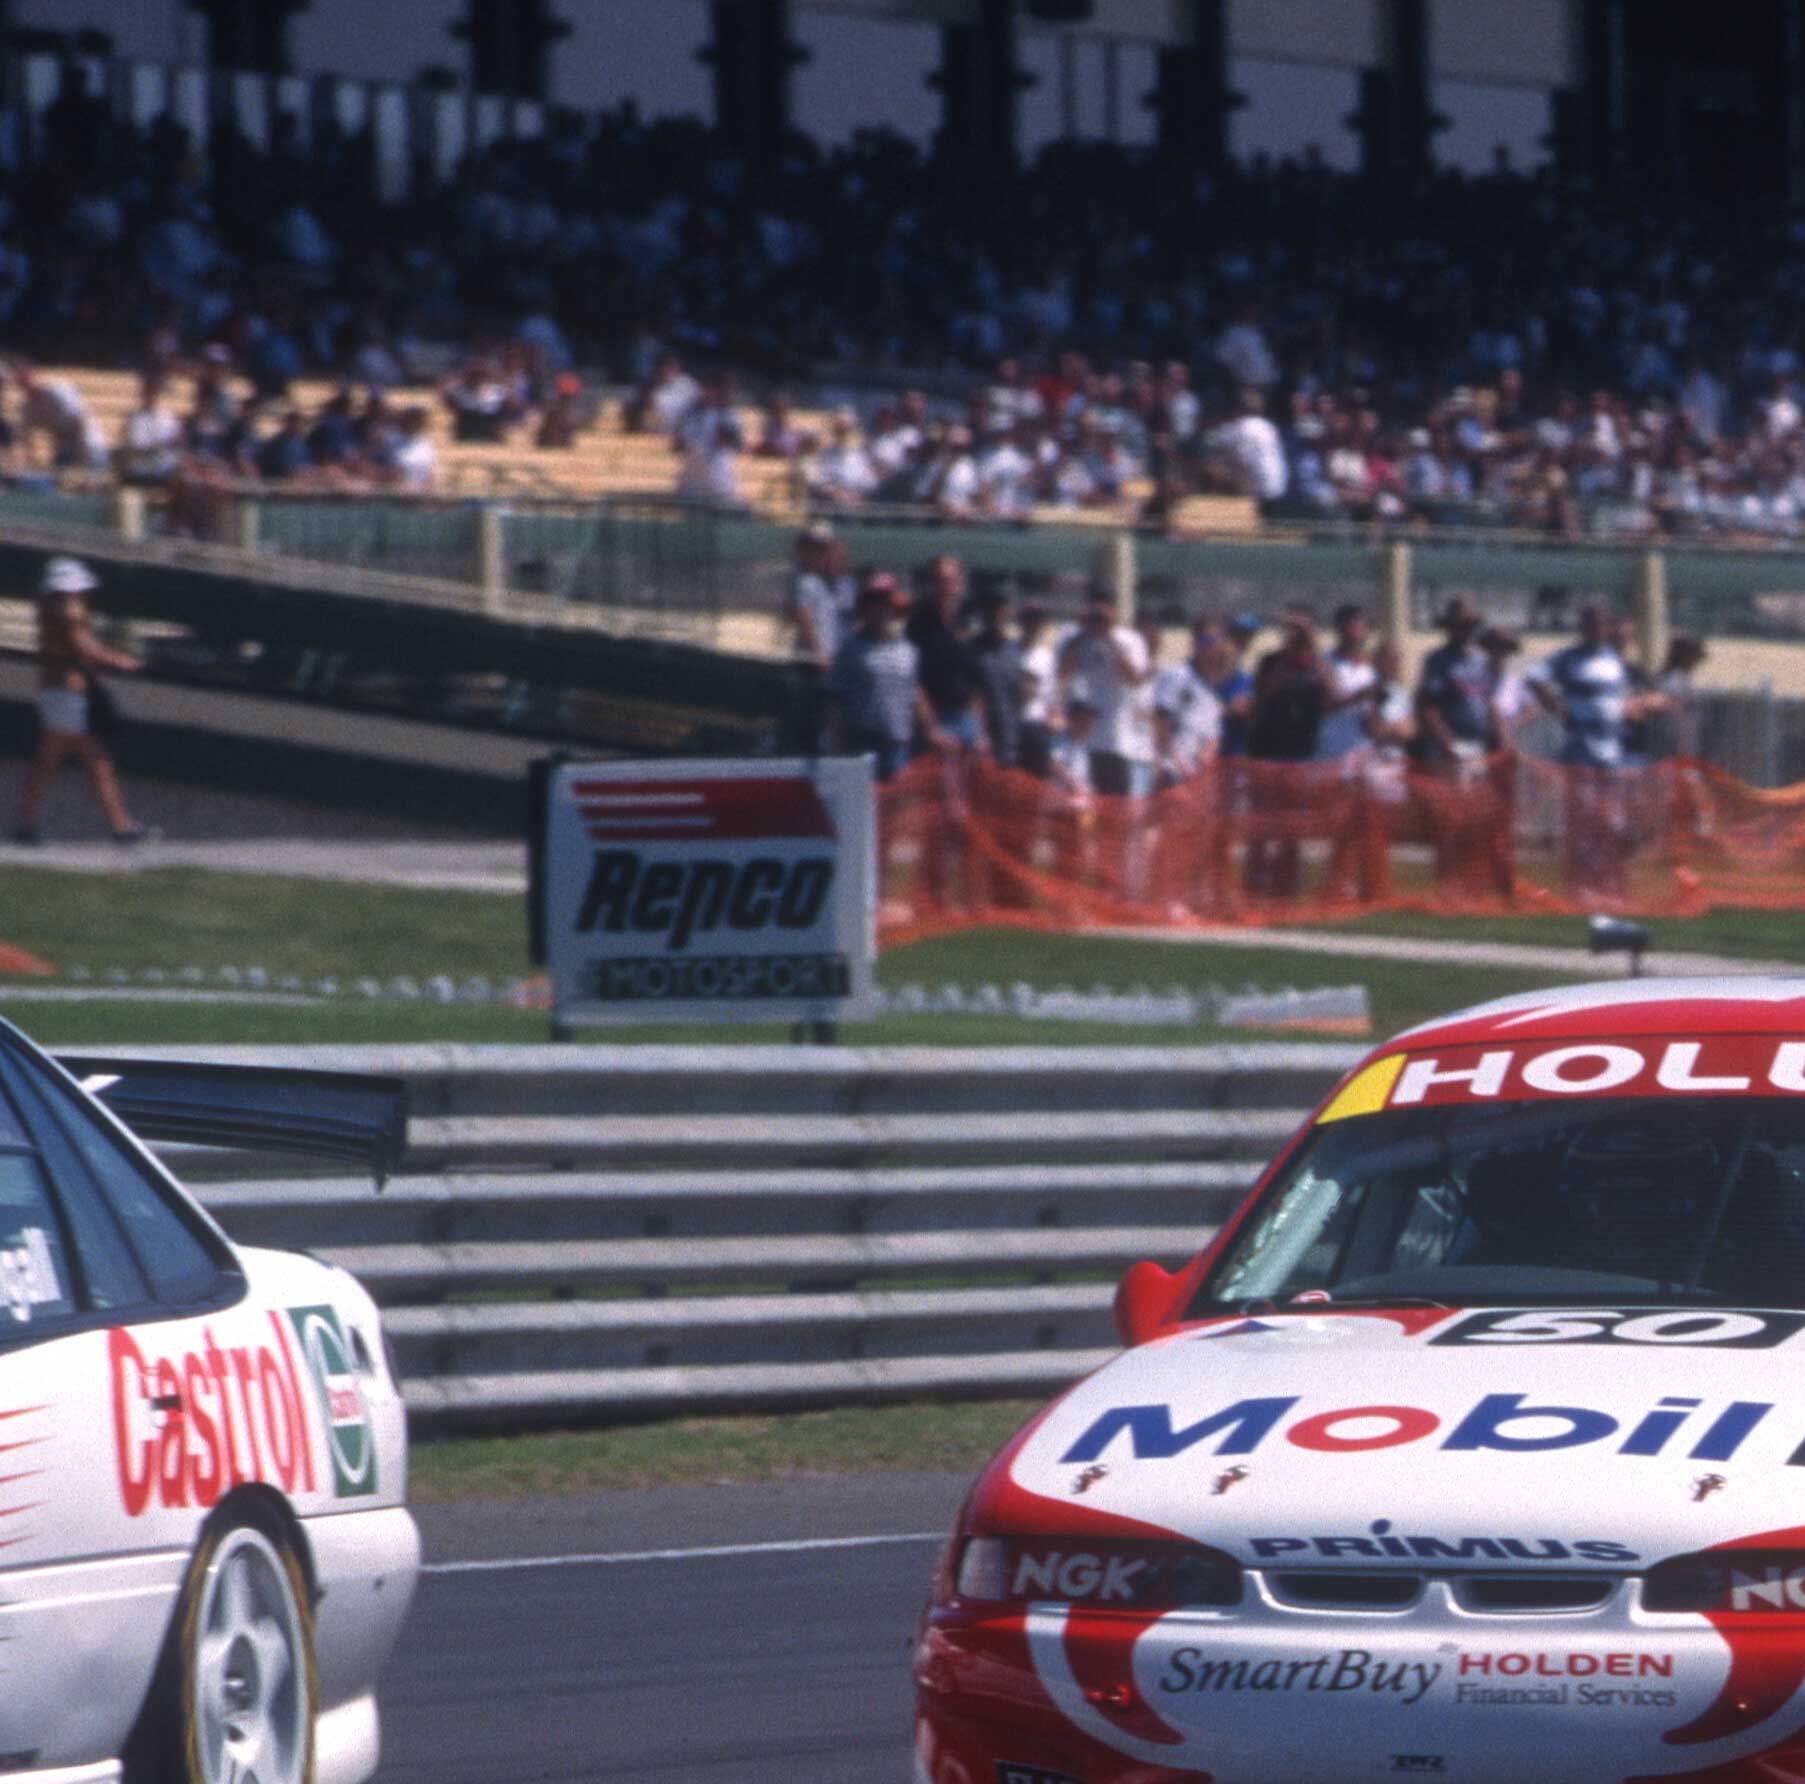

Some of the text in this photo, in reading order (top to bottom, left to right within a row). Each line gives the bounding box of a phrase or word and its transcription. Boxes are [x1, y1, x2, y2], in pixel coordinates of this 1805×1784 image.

[575, 850, 834, 951] Repco
[1462, 1311, 1765, 1345] 50
[107, 1309, 317, 1517] Castrol
[1058, 1394, 1776, 1463] Mobil
[1012, 1552, 1144, 1599] NGK
[1159, 1648, 1674, 1704] SmartBuy HOLDEN
[1456, 1683, 1677, 1707] Financial Services
